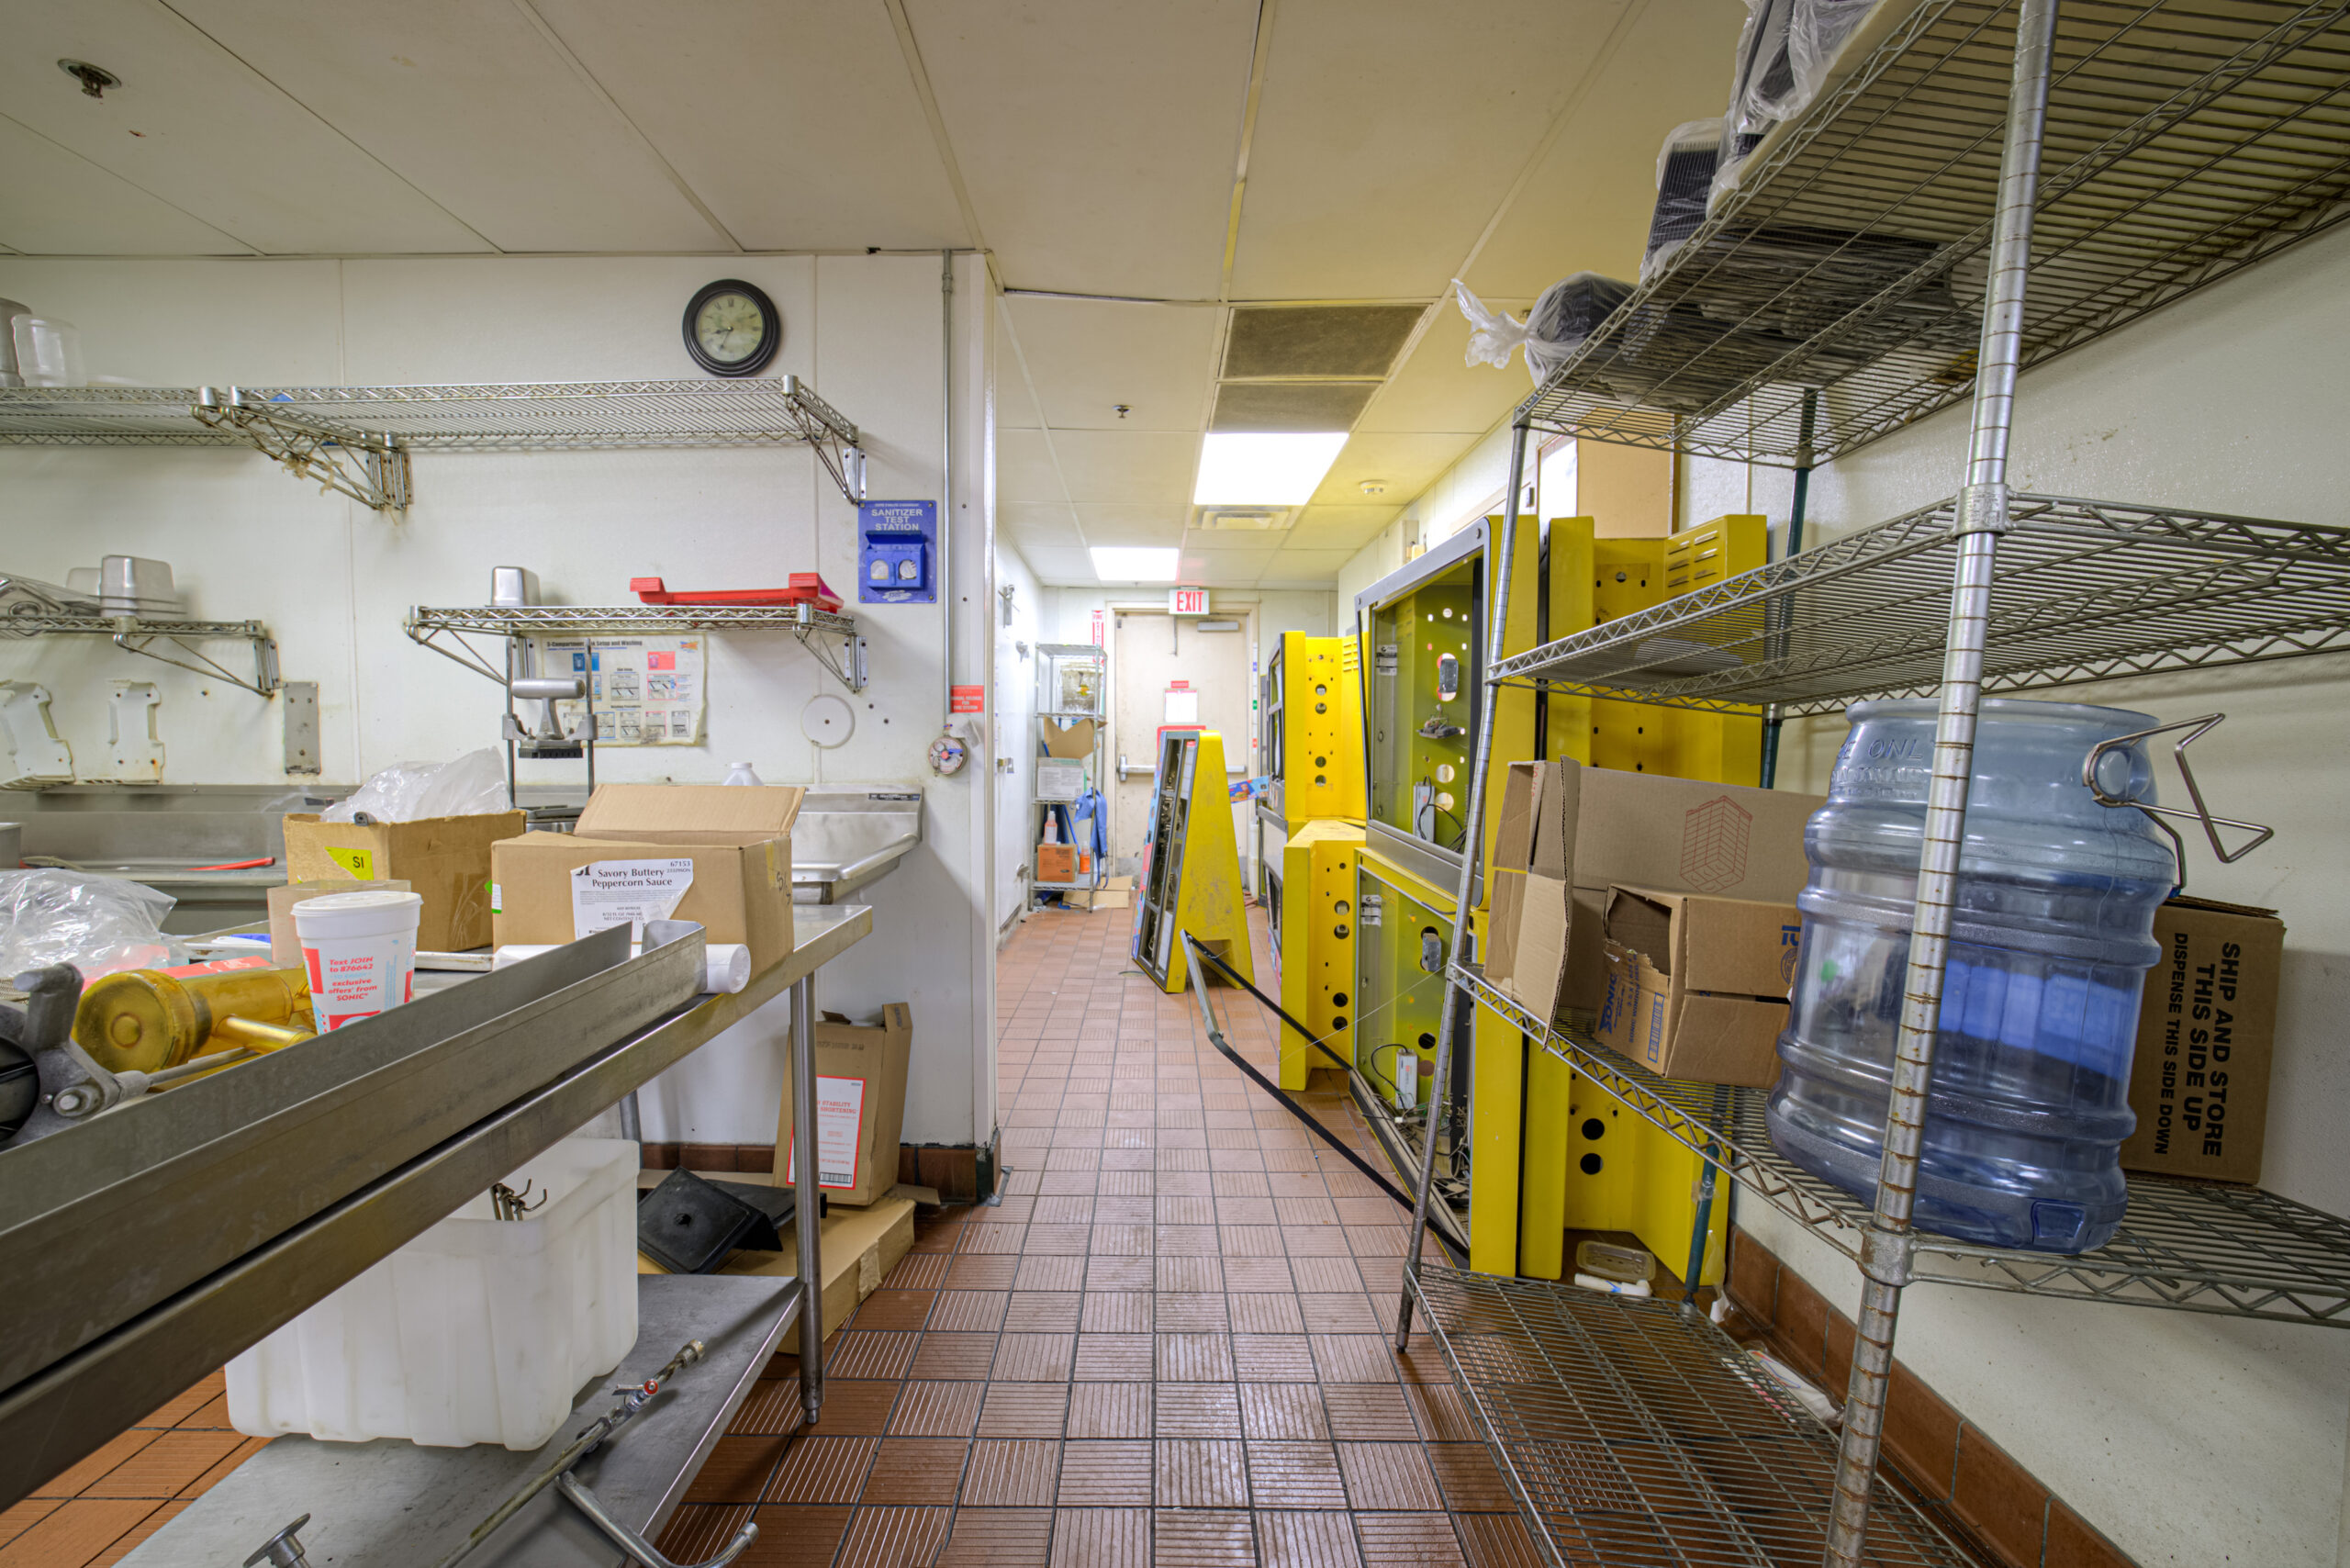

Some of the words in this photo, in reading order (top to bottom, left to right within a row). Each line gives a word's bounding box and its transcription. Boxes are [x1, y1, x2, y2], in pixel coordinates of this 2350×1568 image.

[871, 509, 923, 517] SANITIZER
[1176, 591, 1204, 612] EXIT
[1868, 738, 1936, 760] ONL
[592, 879, 644, 890] Peppercorn
[646, 878, 673, 886] Sauce
[598, 869, 628, 879] Savory
[632, 868, 665, 879] Buttery
[341, 963, 374, 972] 876642
[350, 956, 374, 965] JOIN
[2168, 932, 2188, 1014] DISPENSE
[2221, 942, 2241, 1002] SHIP
[332, 979, 372, 987] exclusive
[1632, 983, 1640, 1017] WINDOW
[2192, 963, 2216, 1021] THIS
[1598, 973, 1618, 1035] SONIC
[1628, 1019, 1637, 1044] SONIC
[2165, 1019, 2180, 1056] THIS
[2212, 1008, 2233, 1063] AND
[2186, 1028, 2209, 1088] SIDE
[2160, 1060, 2177, 1099] SIDE
[820, 1106, 857, 1114] SHORTENING
[822, 1100, 851, 1109] STABILITY
[2183, 1097, 2204, 1132] UP
[2202, 1070, 2229, 1157] STORE
[2154, 1104, 2173, 1155] DOWN
